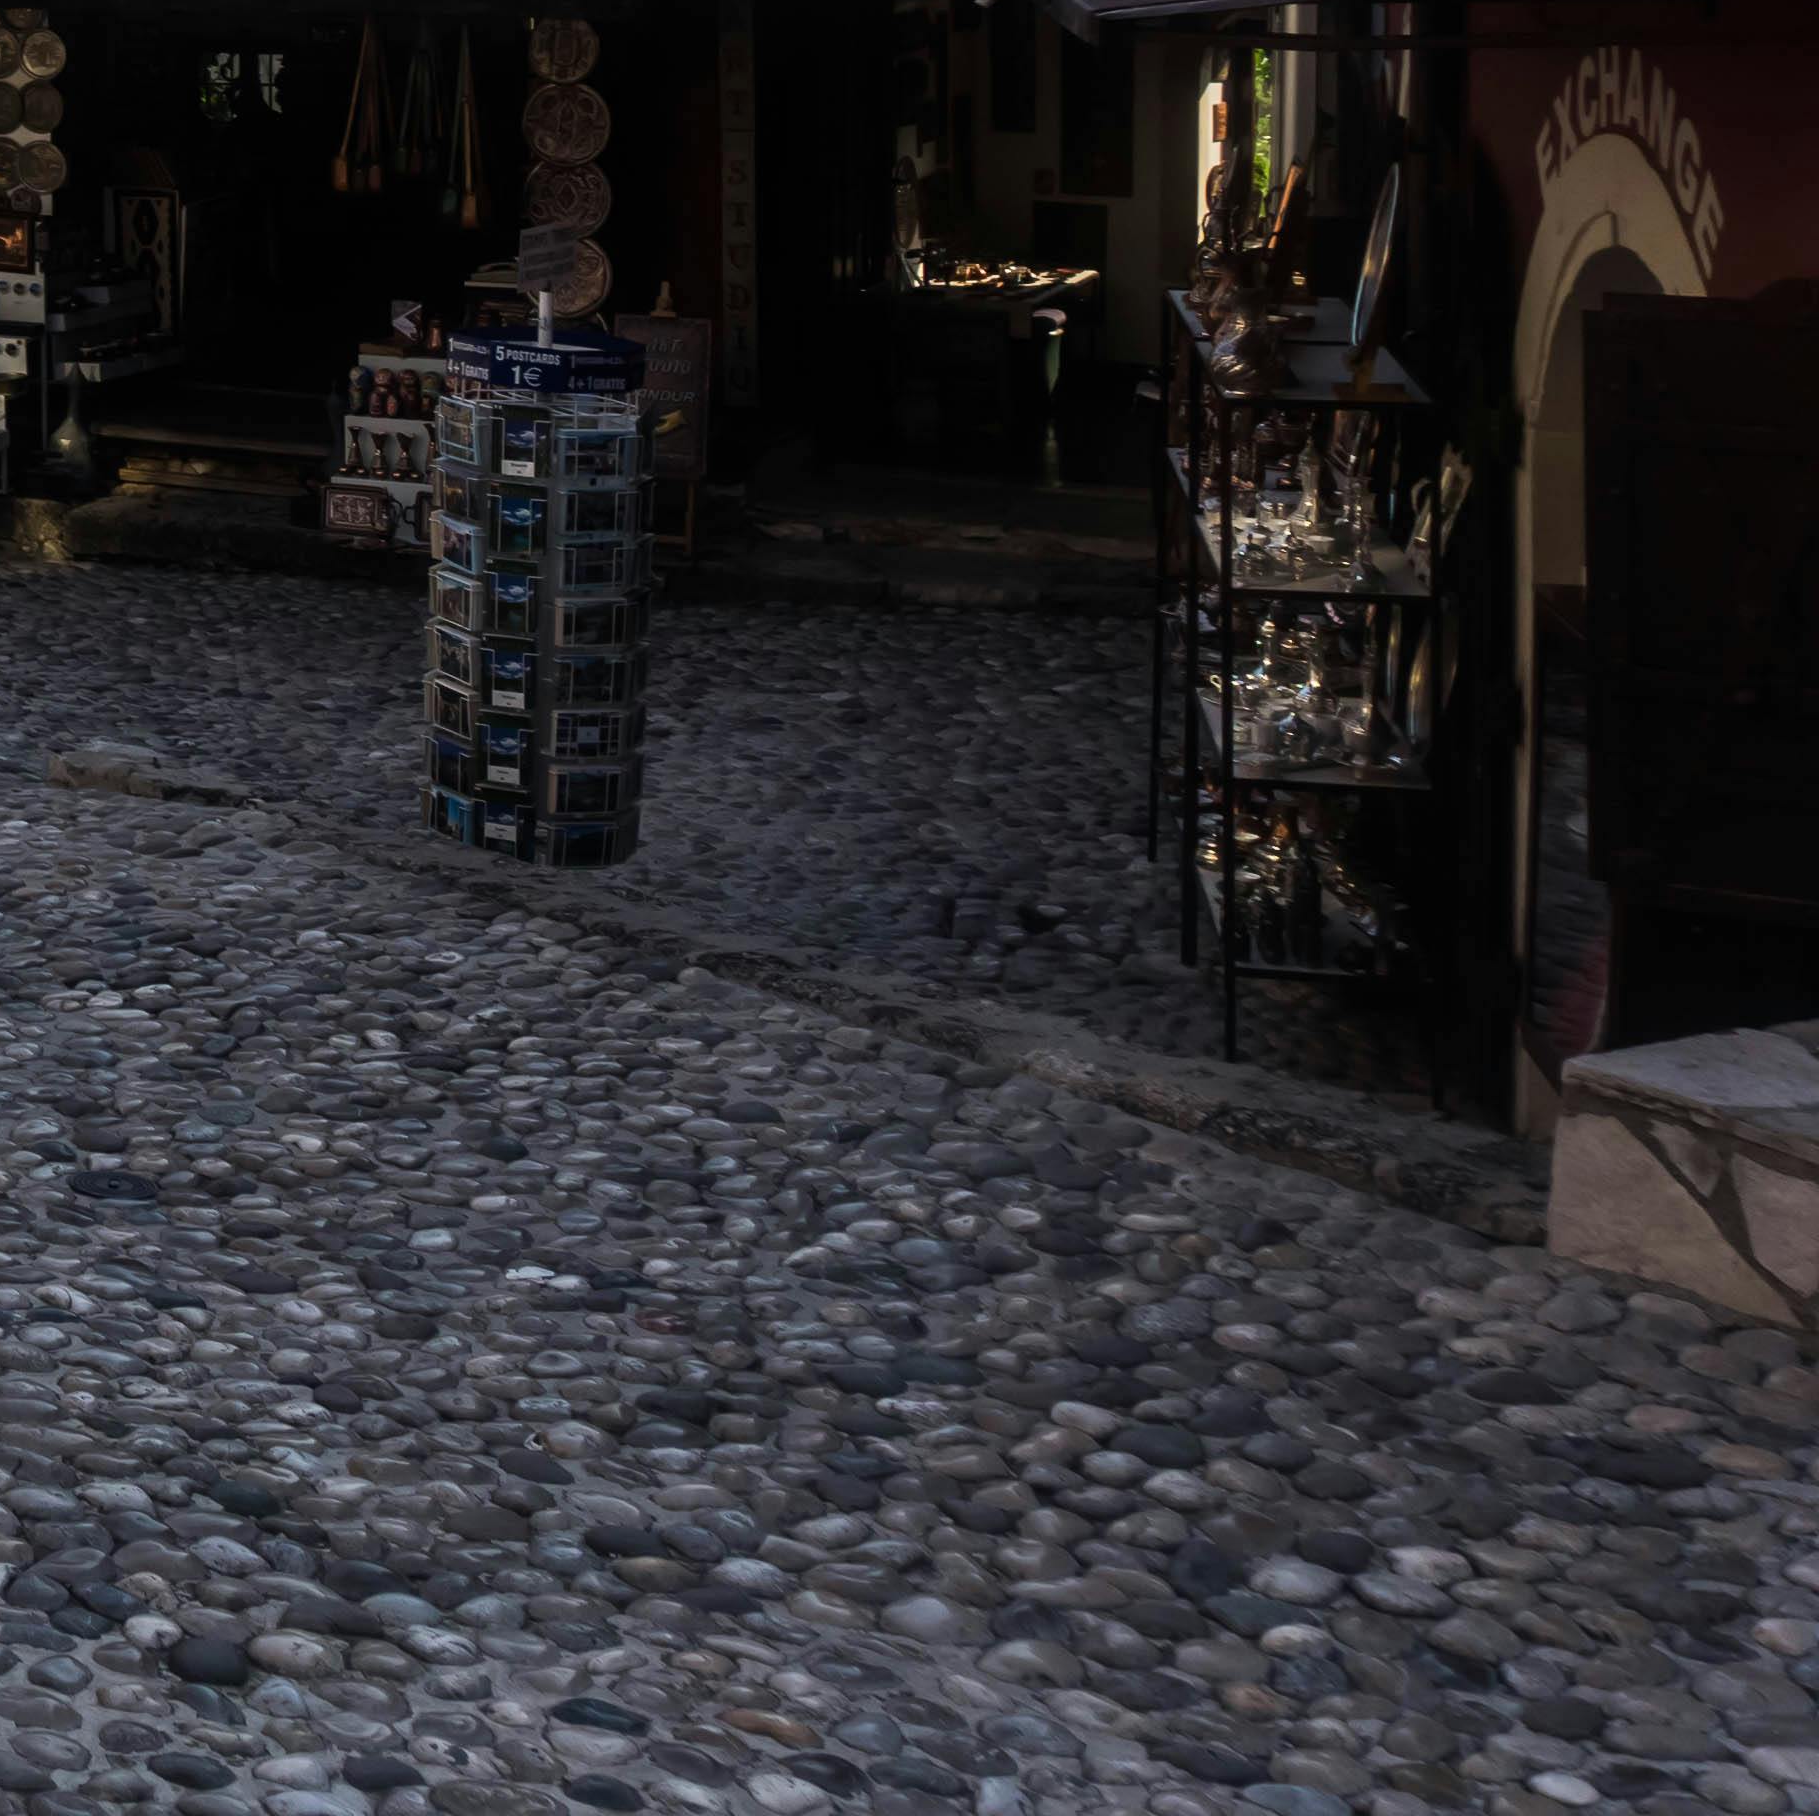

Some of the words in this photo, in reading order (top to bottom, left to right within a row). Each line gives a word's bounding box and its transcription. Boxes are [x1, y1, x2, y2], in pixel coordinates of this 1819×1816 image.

[1535, 44, 1724, 280] EXCHANGE
[495, 346, 505, 361] 5
[505, 350, 561, 366] POSTCARDS
